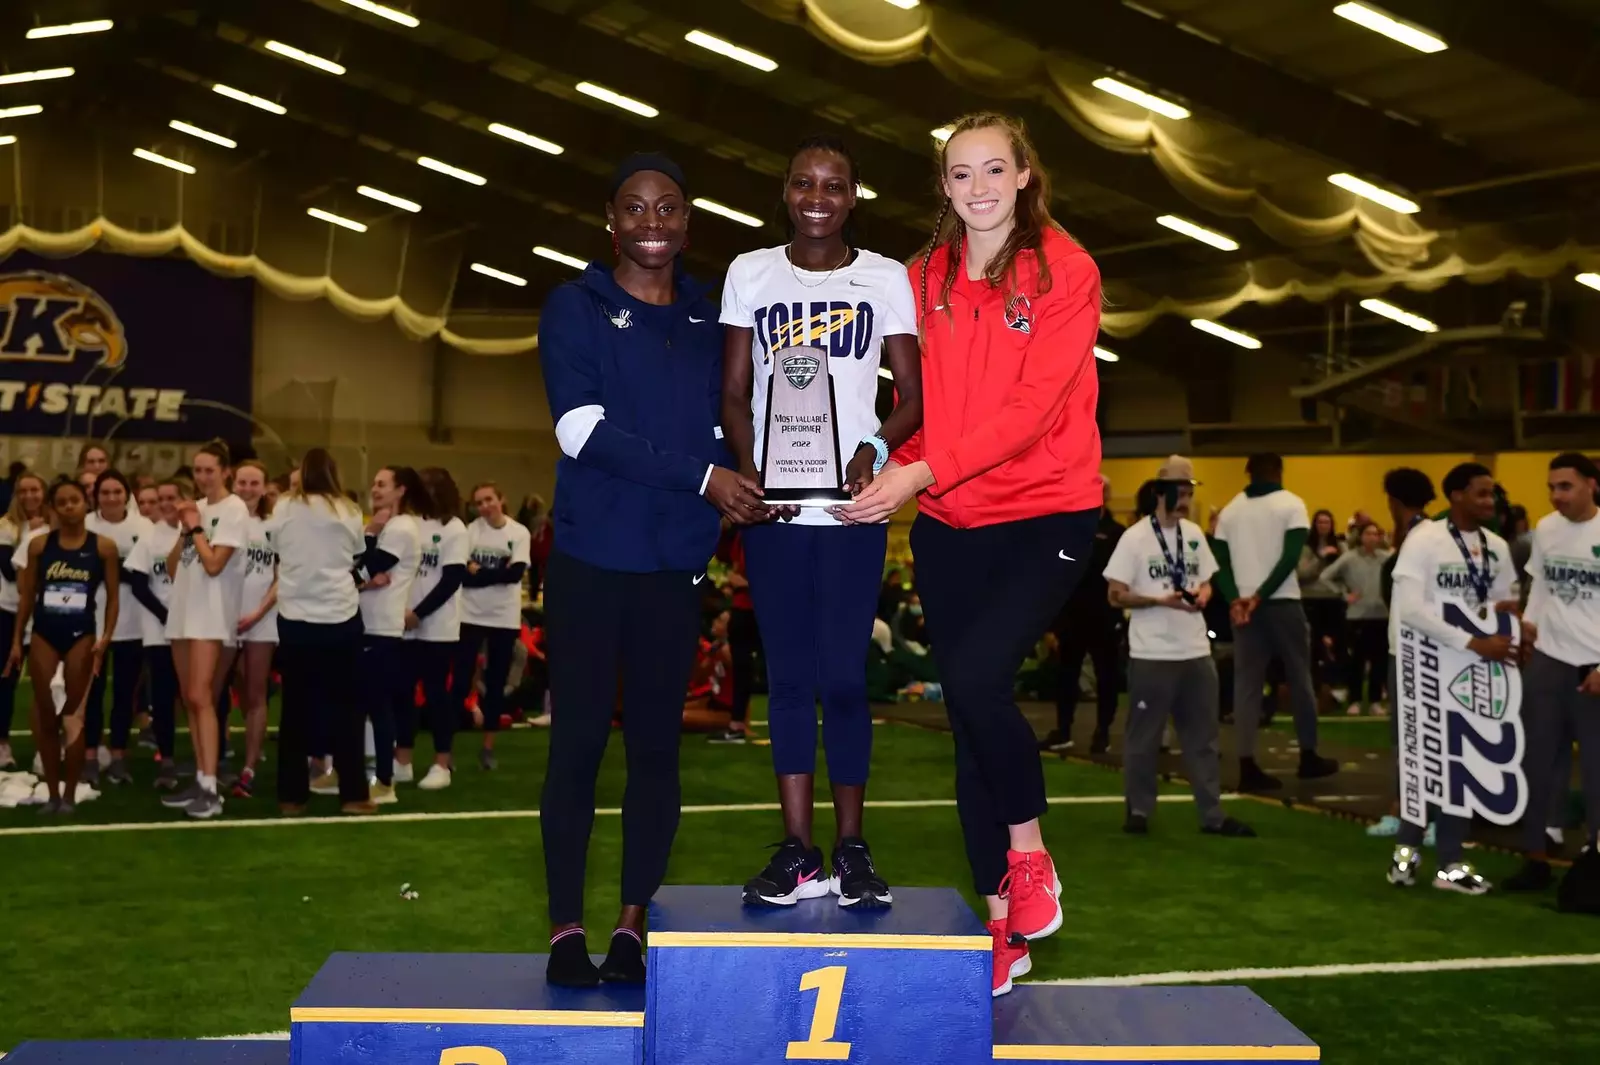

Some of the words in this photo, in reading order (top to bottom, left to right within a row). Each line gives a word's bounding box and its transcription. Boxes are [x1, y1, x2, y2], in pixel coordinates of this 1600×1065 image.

[754, 301, 874, 365] TOLEDO
[41, 383, 187, 421] STATE
[774, 414, 793, 423] MOST
[795, 413, 828, 423] VALUABLE
[781, 425, 821, 433] PERFORMER
[1402, 643, 1416, 700] INDOOR
[1403, 704, 1418, 756] TRACK
[1419, 635, 1443, 798] HAMPIONS
[1405, 771, 1420, 818] FIELD
[786, 966, 851, 1060] 1
